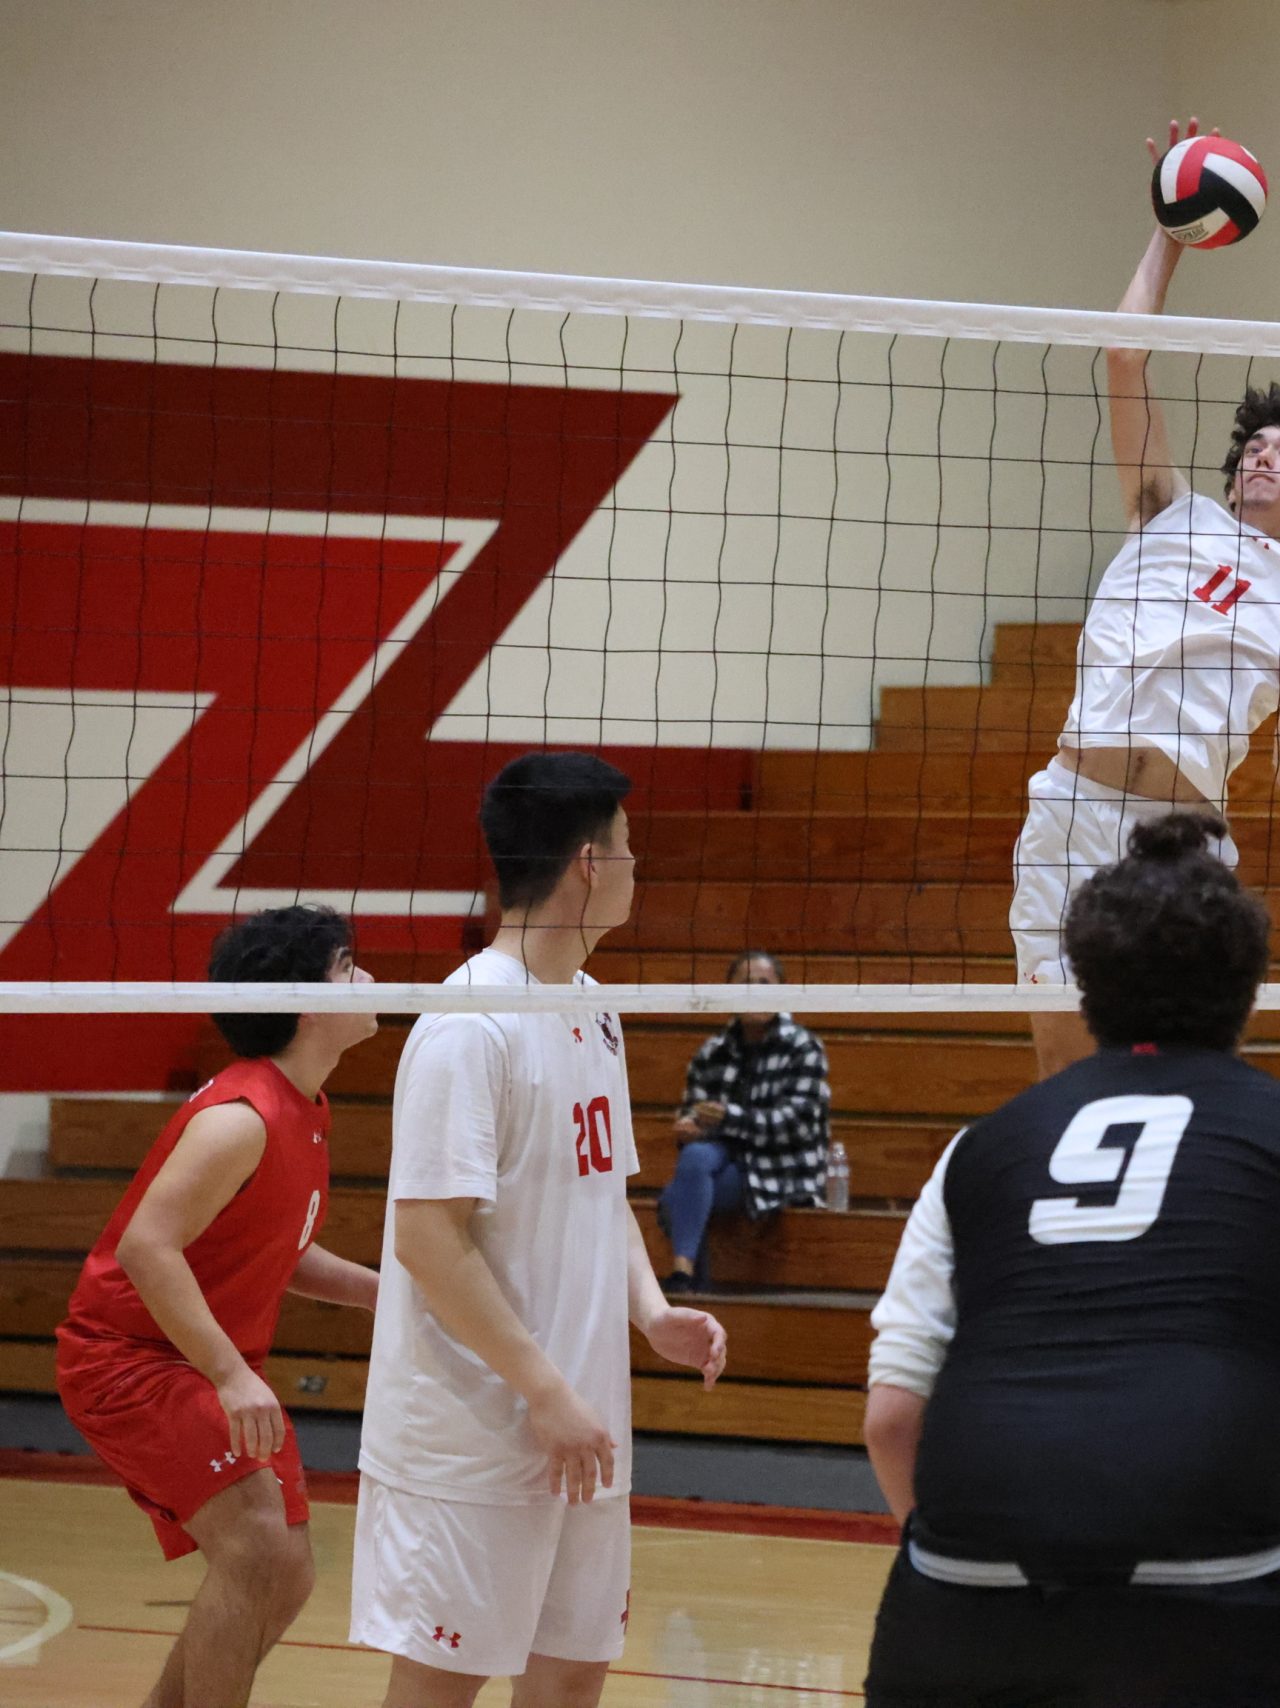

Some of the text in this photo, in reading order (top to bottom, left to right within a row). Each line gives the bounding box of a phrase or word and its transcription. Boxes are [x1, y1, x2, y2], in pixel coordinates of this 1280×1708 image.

[1193, 565, 1252, 616] 11
[572, 1096, 613, 1177] 20
[1028, 1094, 1194, 1245] 9
